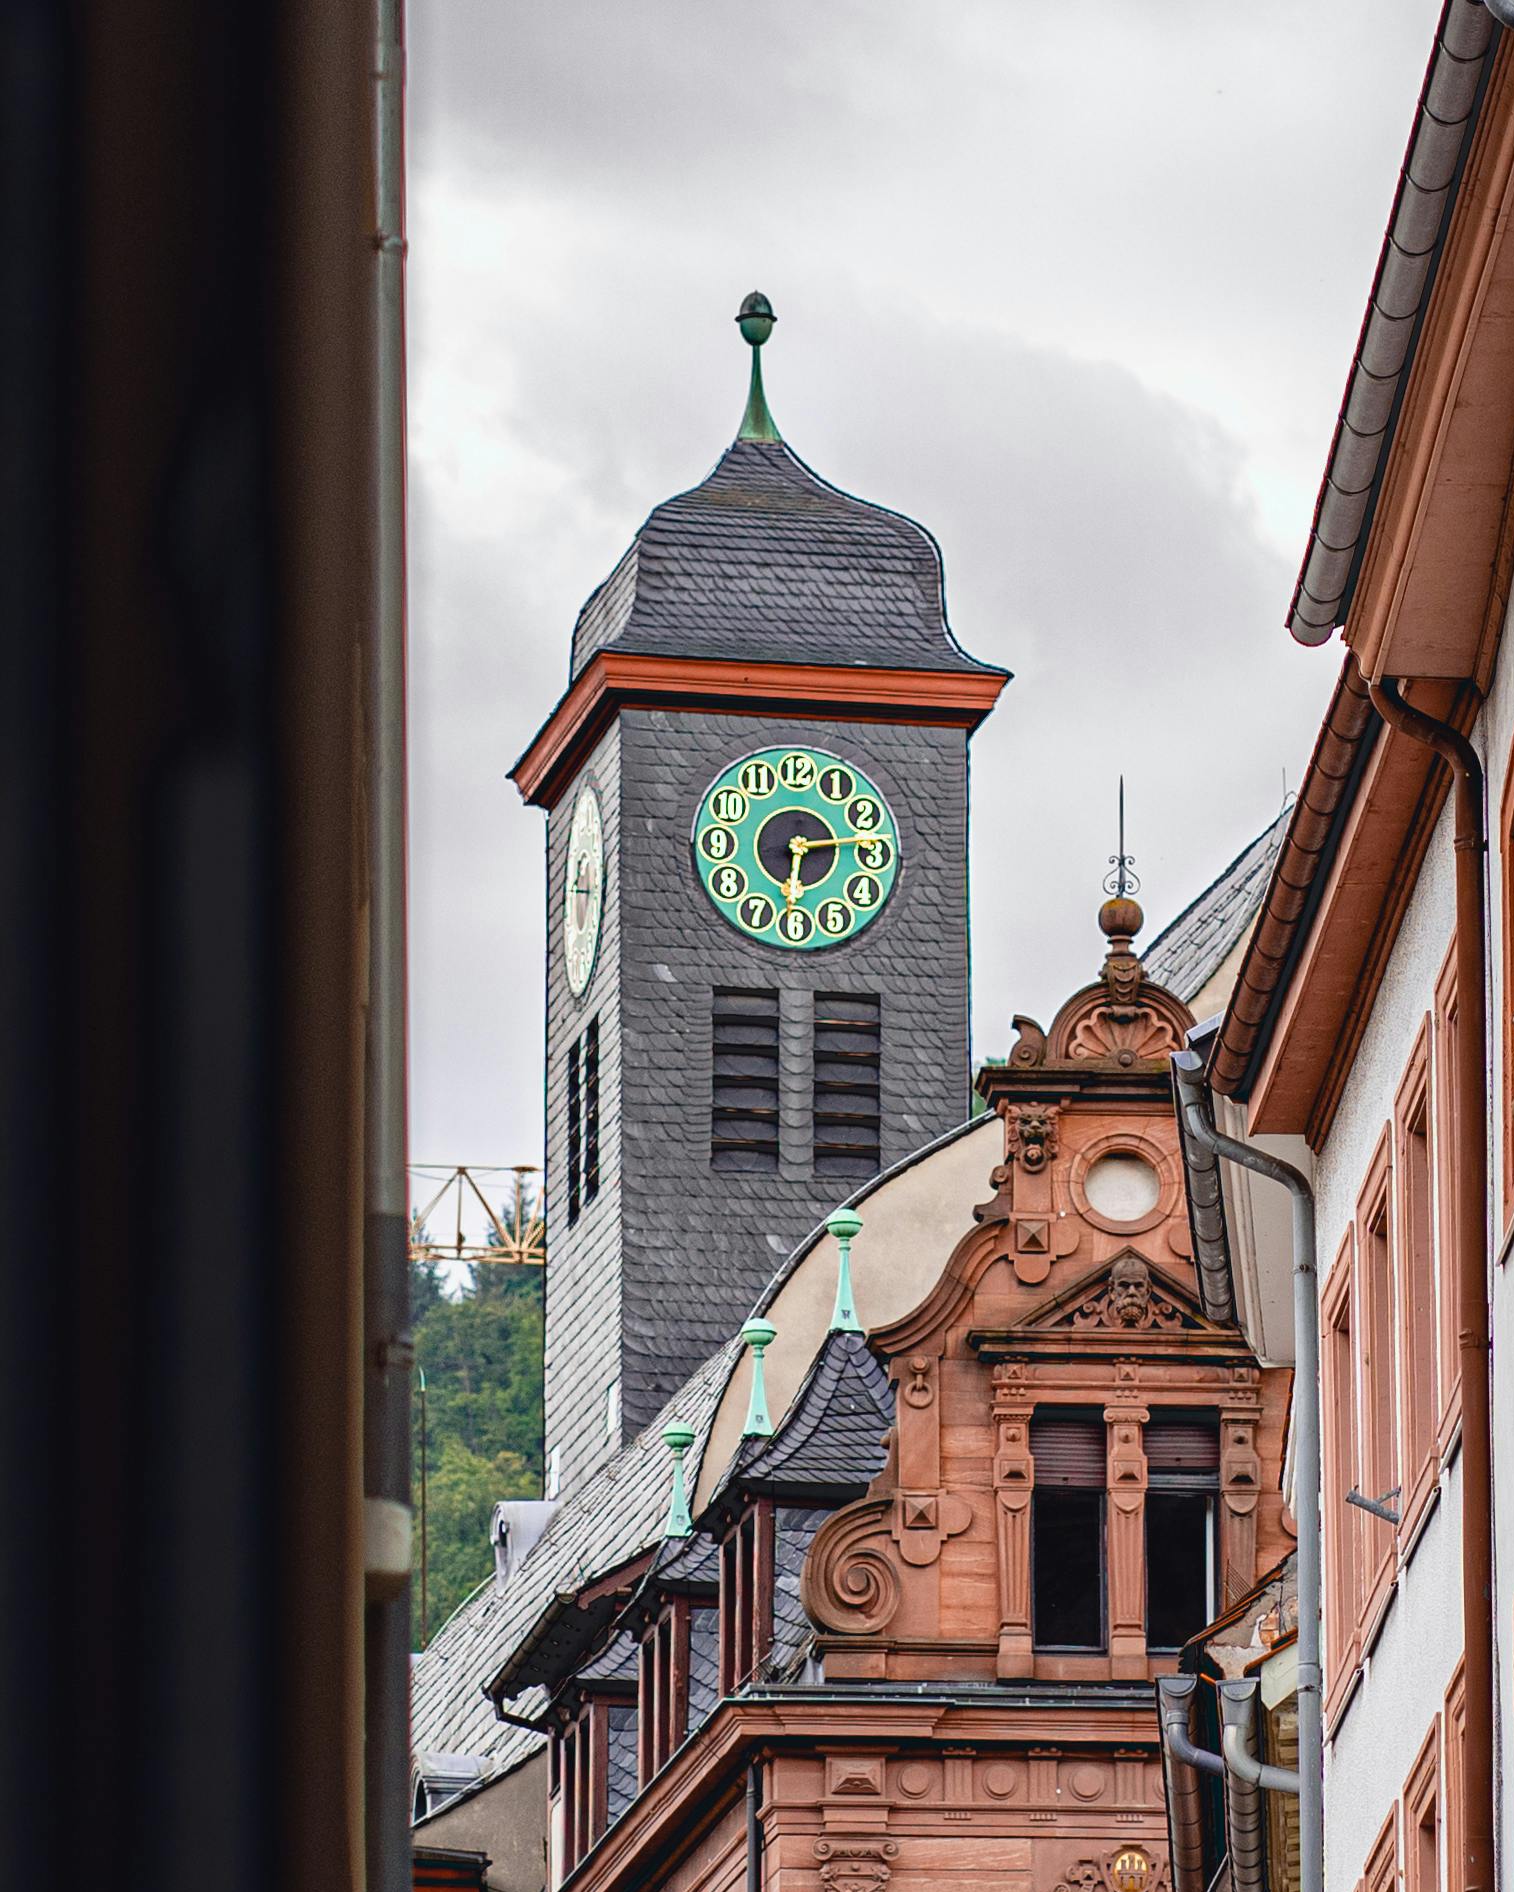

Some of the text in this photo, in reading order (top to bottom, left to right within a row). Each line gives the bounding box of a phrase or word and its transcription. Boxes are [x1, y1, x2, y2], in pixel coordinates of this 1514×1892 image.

[746, 766, 770, 793] 11
[785, 758, 812, 785] 12
[830, 772, 842, 799] 1
[718, 792, 743, 819] 10
[855, 802, 873, 829] 2
[711, 830, 727, 857] 9
[865, 840, 885, 867] 3
[720, 870, 738, 896] 8
[853, 877, 872, 904] 4
[749, 900, 766, 927] 7
[787, 913, 803, 939] 6
[827, 904, 845, 930] 5
